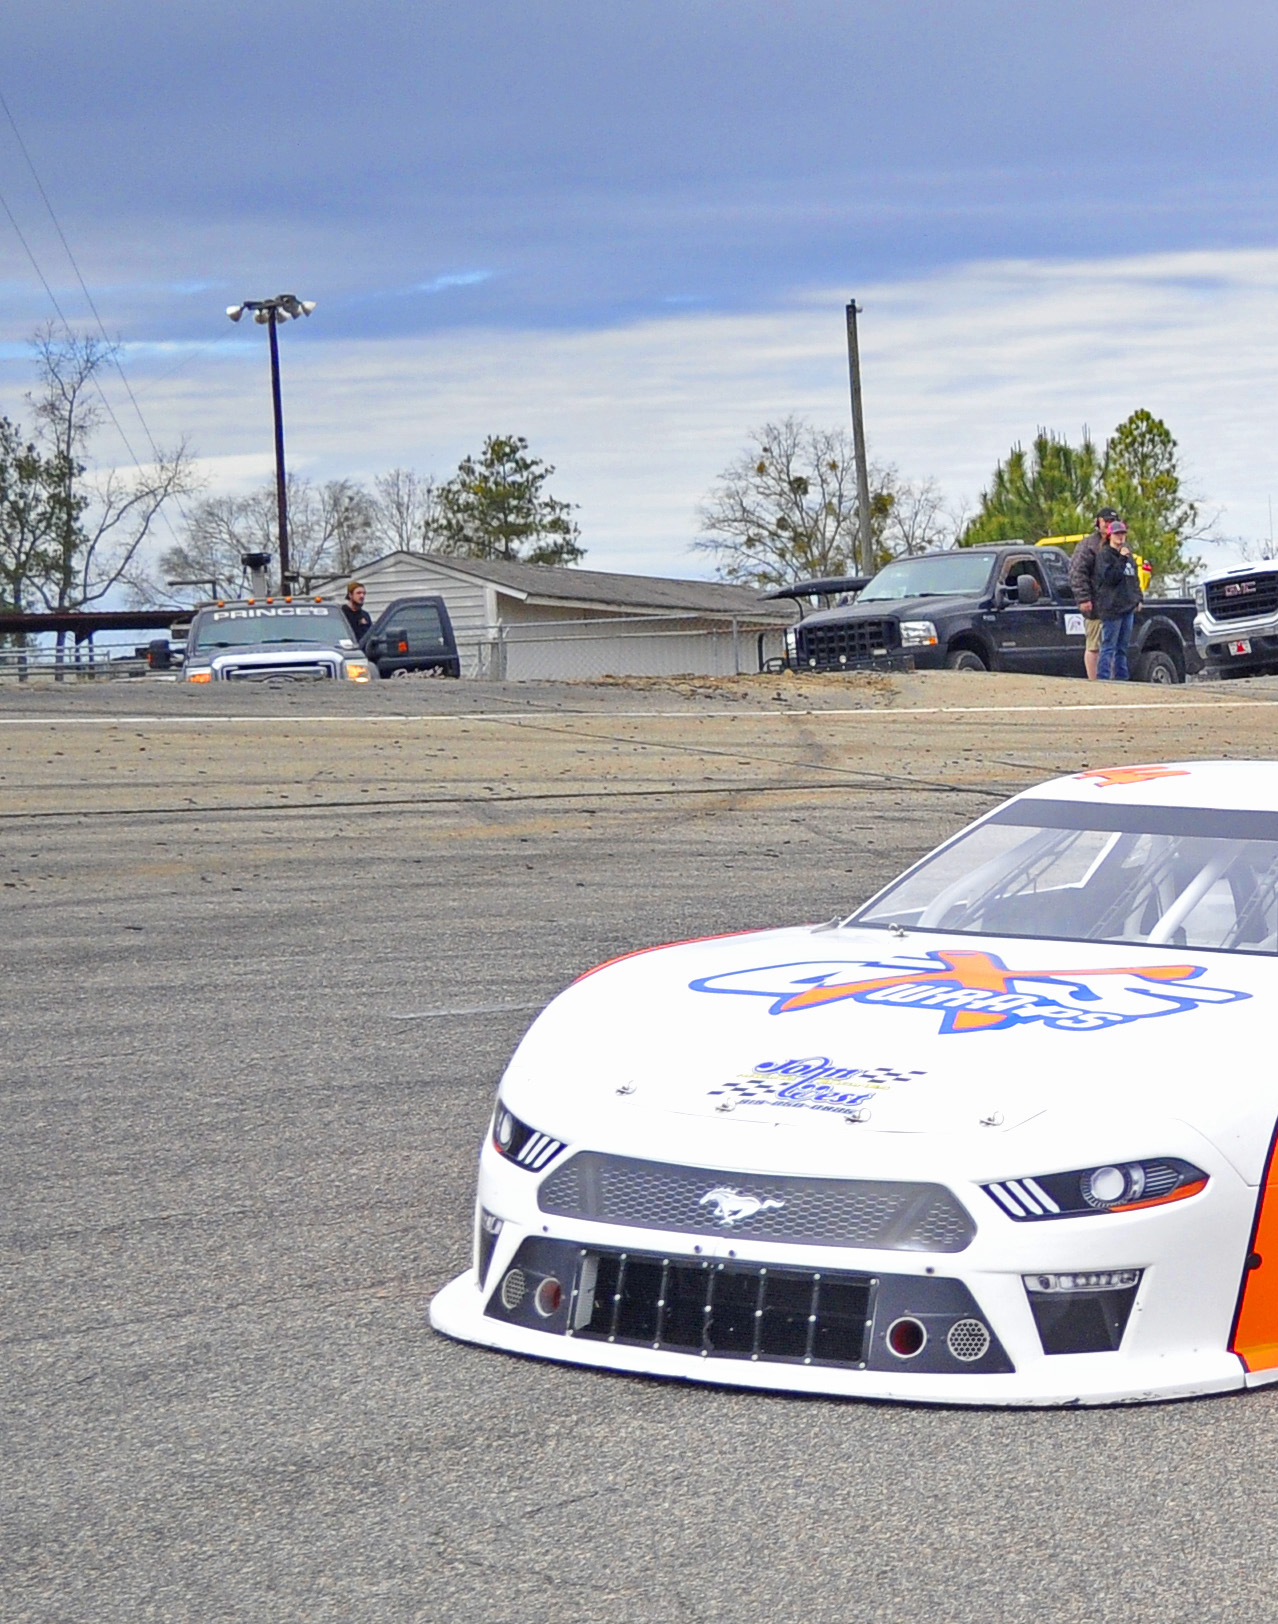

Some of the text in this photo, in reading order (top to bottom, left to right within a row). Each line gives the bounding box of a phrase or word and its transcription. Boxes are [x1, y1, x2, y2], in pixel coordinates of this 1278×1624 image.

[1224, 580, 1257, 597] GMC
[866, 982, 1123, 1029] WRAPS
[753, 1056, 863, 1080] John
[775, 1082, 876, 1106] West
